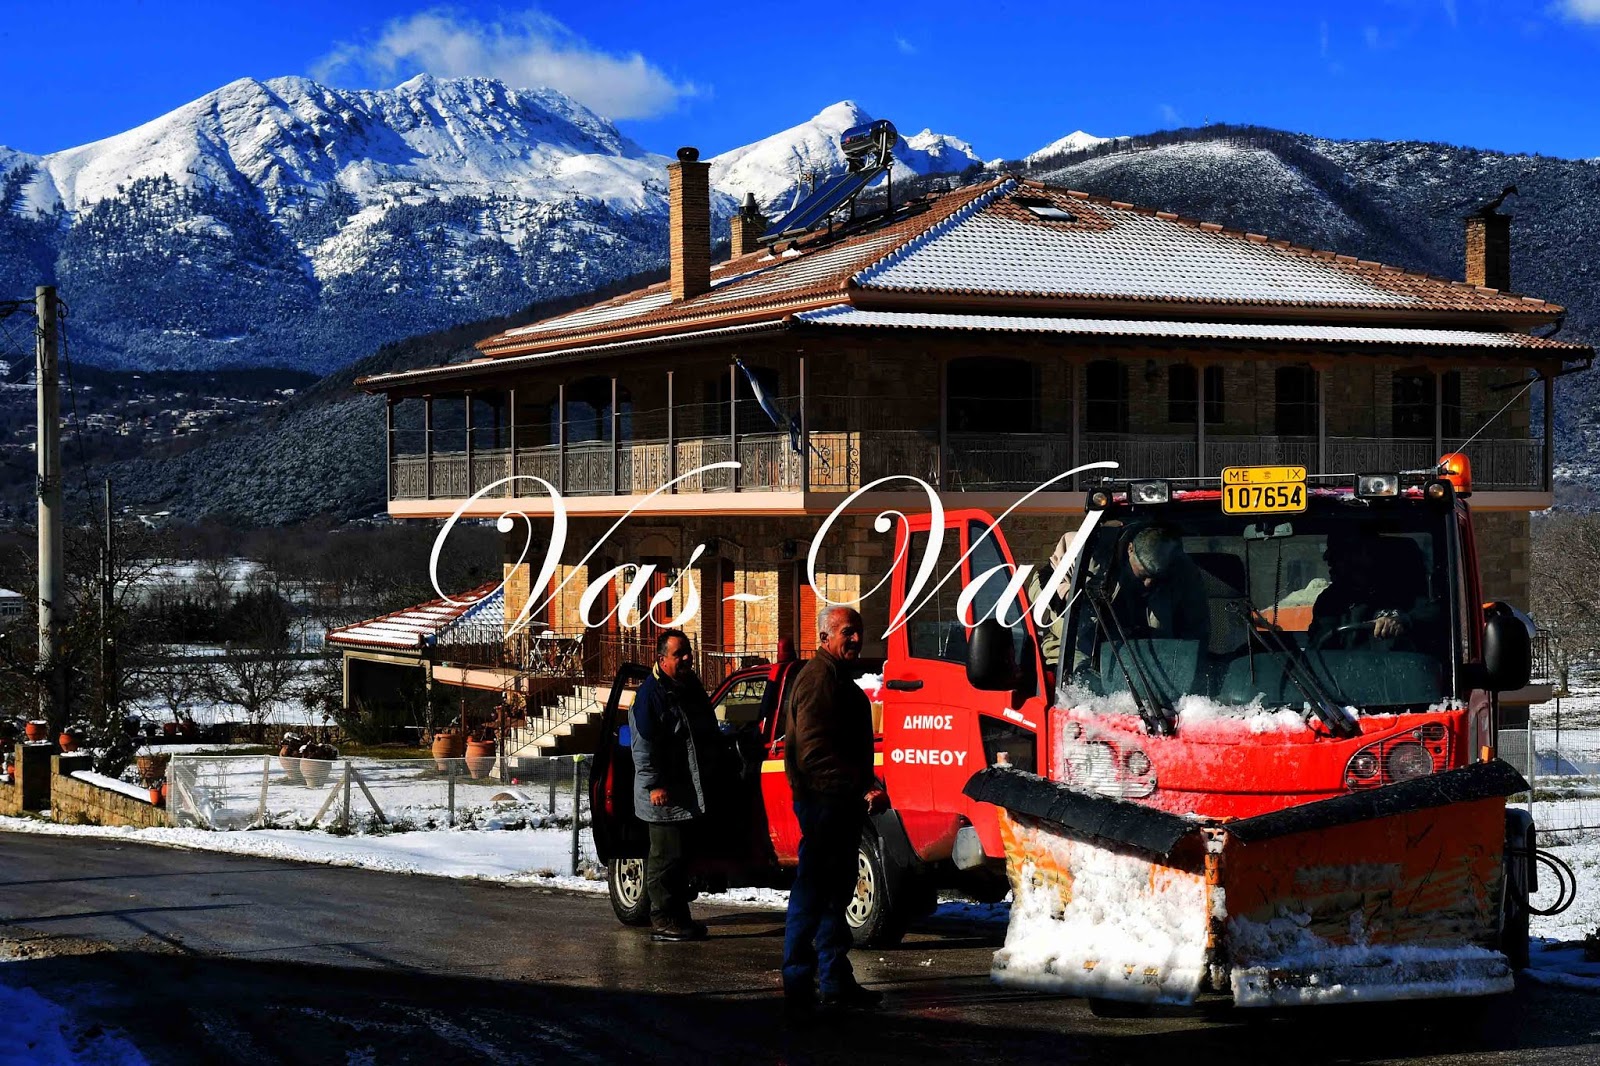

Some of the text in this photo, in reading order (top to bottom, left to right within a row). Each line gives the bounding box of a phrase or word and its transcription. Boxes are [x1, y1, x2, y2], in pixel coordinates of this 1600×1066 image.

[1227, 485, 1302, 509] 107654
[903, 715, 953, 730] ΔΗΜΟΣ
[891, 748, 967, 766] ΦΕΝΕΟΥ
